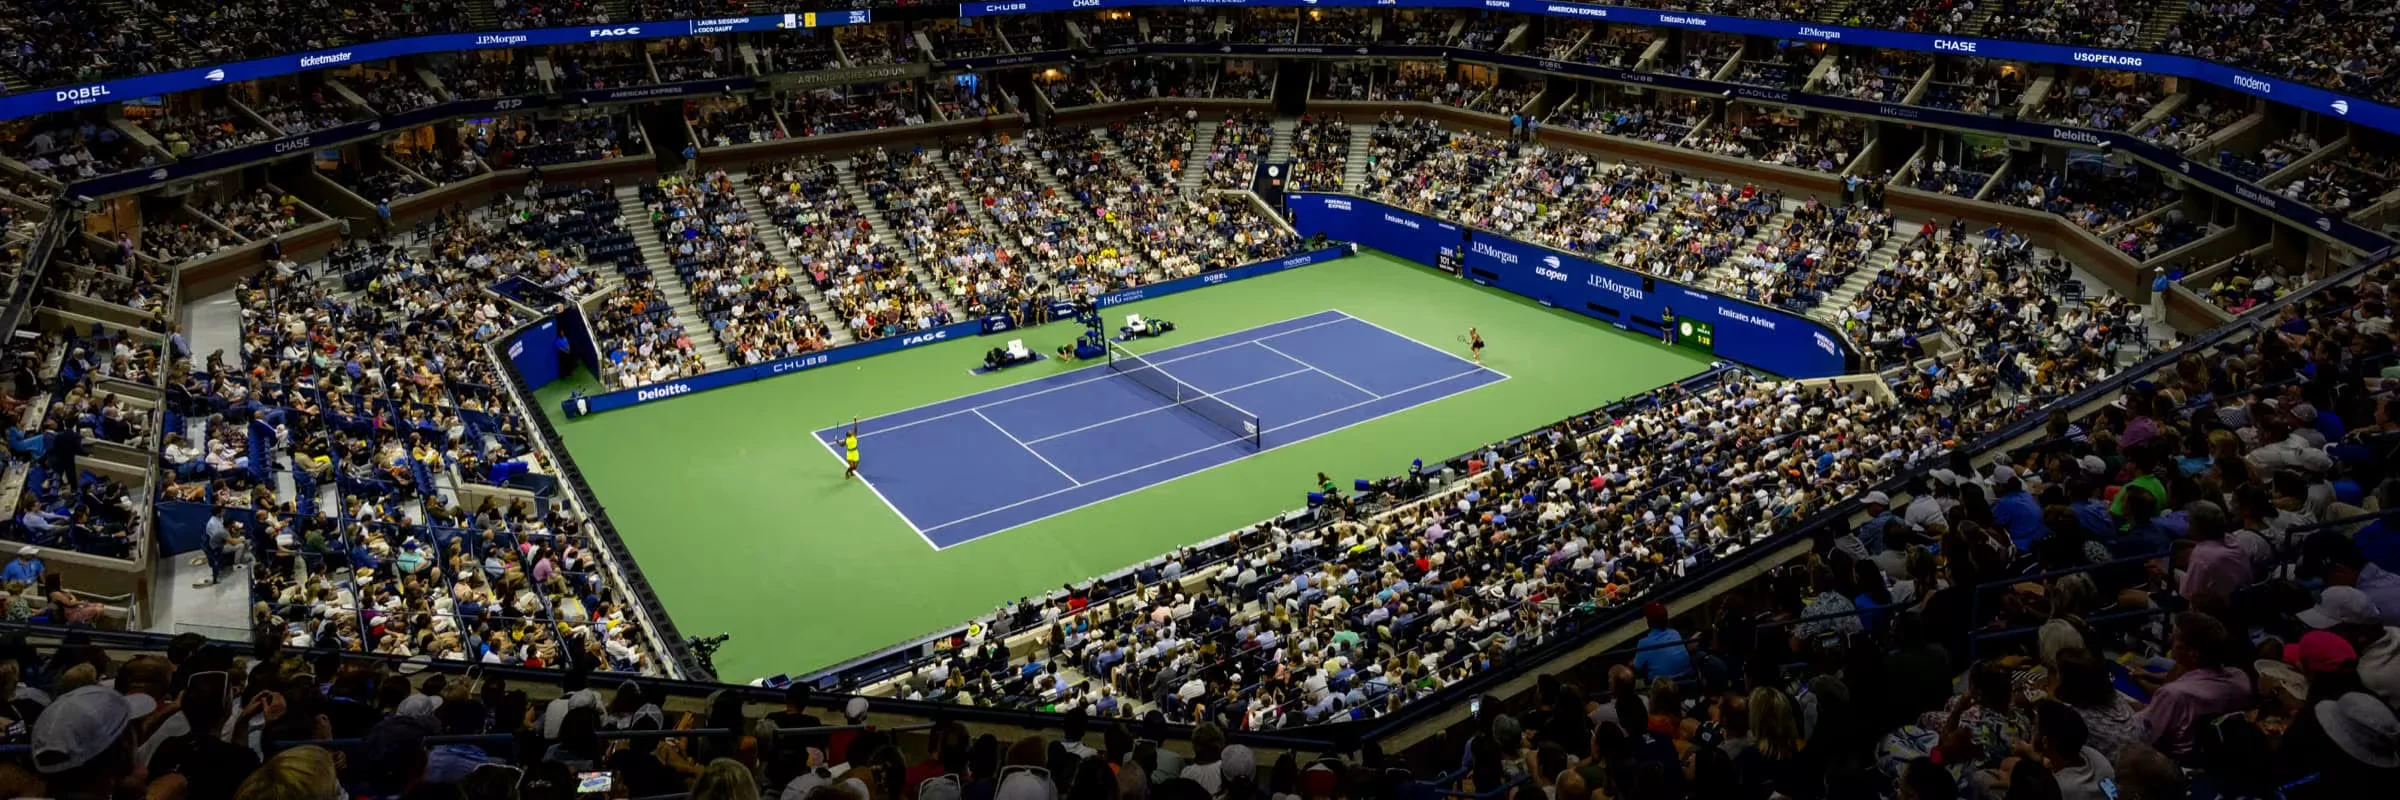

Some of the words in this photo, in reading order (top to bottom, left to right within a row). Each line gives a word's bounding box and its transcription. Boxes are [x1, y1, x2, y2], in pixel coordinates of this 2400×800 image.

[986, 3, 1026, 12] CHUBB
[1934, 39, 1976, 52] CHASE
[301, 52, 352, 67] ticketmaster
[2074, 52, 2142, 66] USOPEN.ORG
[2234, 75, 2270, 93] moderna
[56, 85, 111, 102] DOBEL
[1738, 88, 1788, 100] CADILLAC
[275, 137, 310, 153] CHASE
[1546, 269, 1568, 282] open
[1587, 273, 1643, 300] J.P.Morgan
[1103, 294, 1122, 306] IHG
[1718, 306, 1749, 322] Emirates
[1750, 315, 1776, 330] Airline
[773, 354, 827, 373] CHUBB
[638, 383, 691, 401] Deloitte.
